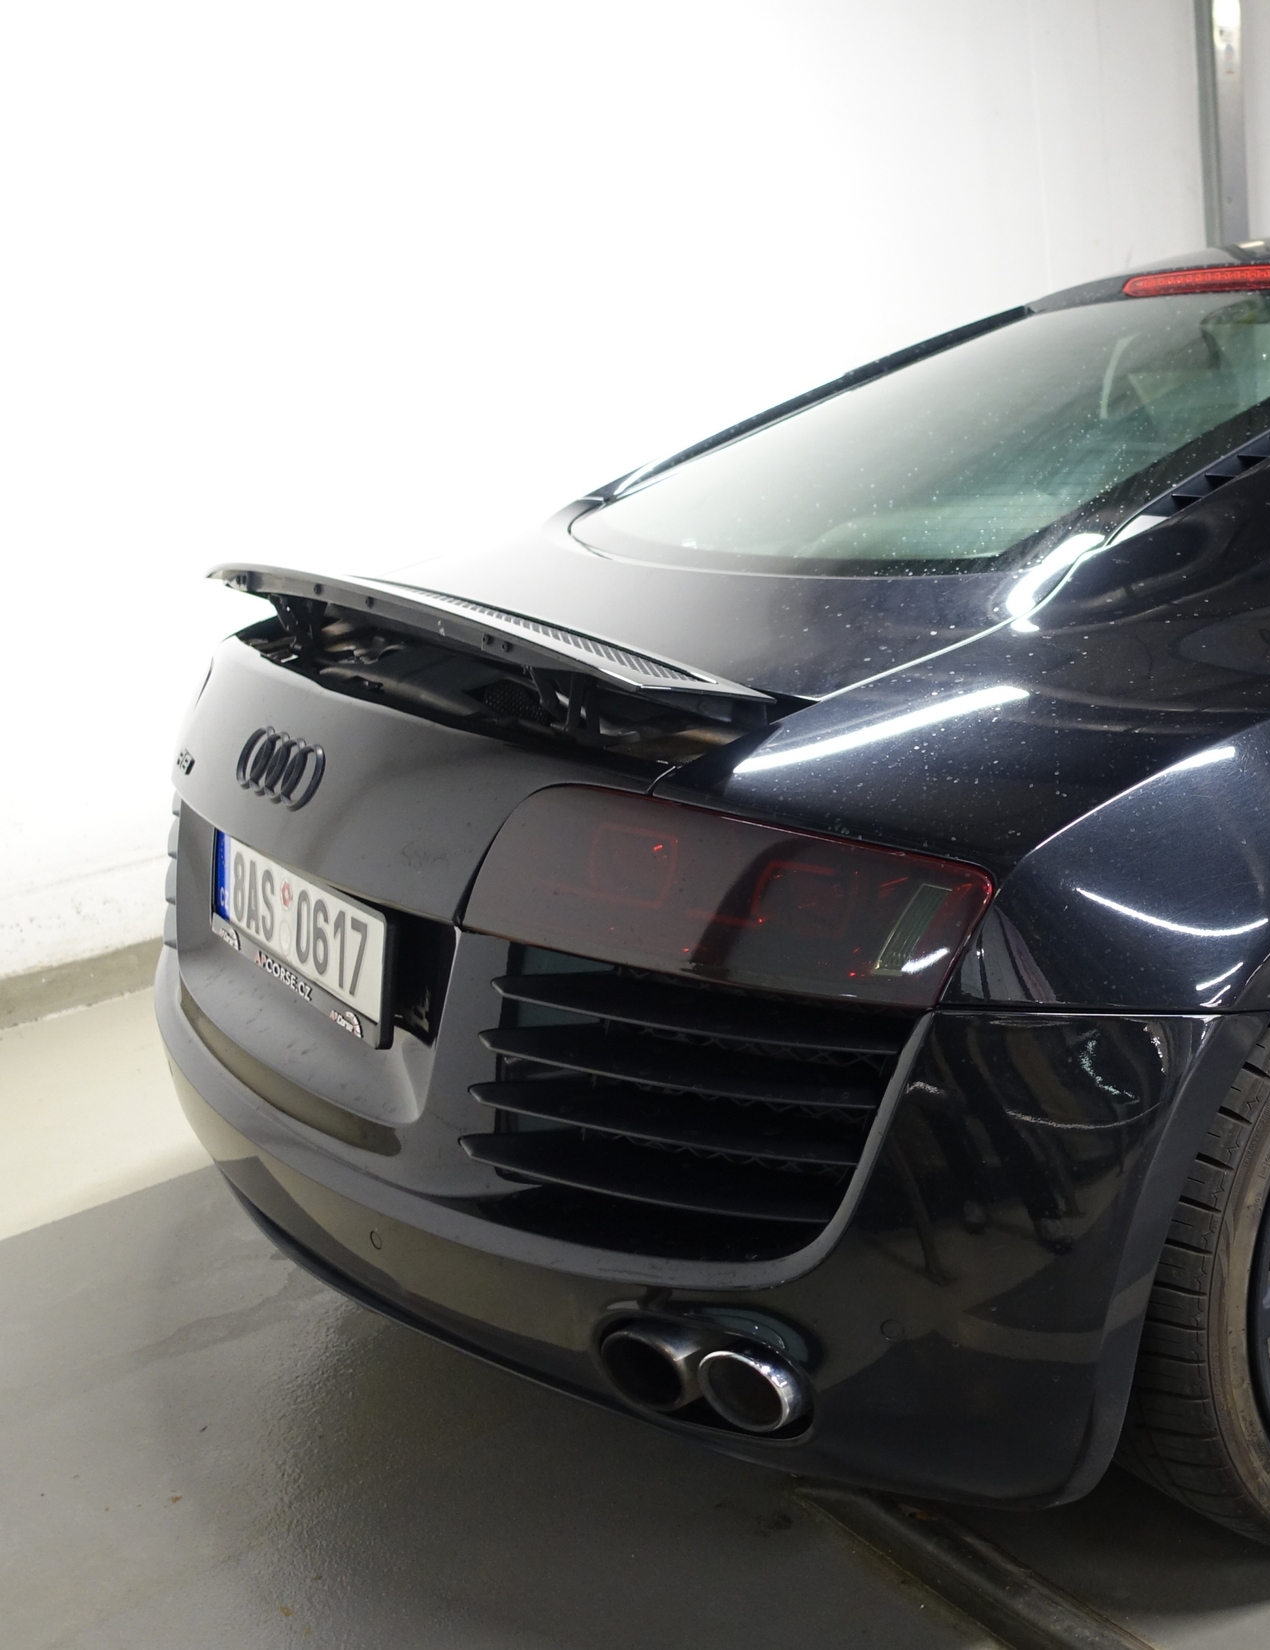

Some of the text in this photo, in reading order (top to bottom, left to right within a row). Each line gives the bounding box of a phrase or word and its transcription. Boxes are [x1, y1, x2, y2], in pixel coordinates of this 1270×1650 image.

[233, 851, 368, 997] 8AS 0617
[254, 950, 312, 1002] APCORSE.CZ
